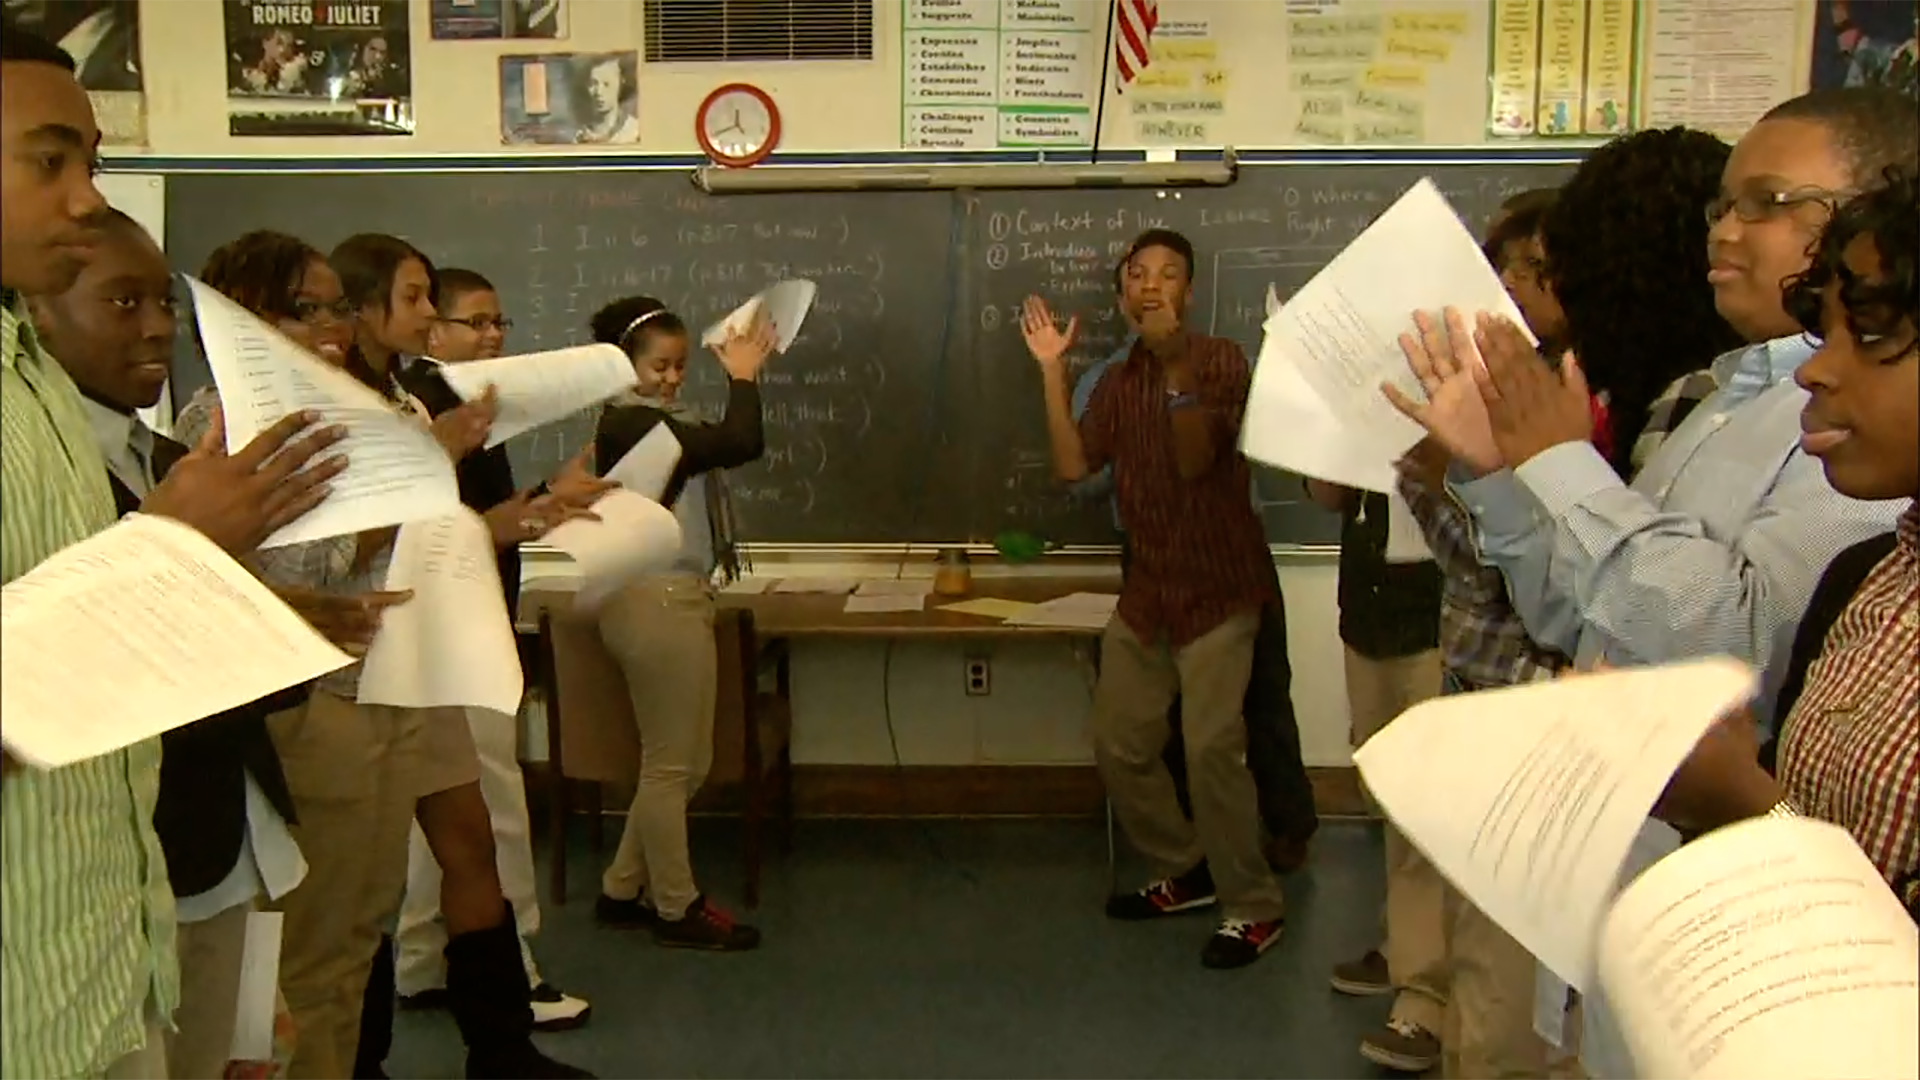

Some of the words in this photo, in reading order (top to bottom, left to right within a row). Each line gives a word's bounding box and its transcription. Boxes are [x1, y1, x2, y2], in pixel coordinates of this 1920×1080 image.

[252, 6, 313, 25] ROMEO
[327, 6, 381, 25] JULIET
[920, 63, 986, 71] Establishes
[1017, 207, 1094, 236] Context
[1106, 207, 1127, 231] of
